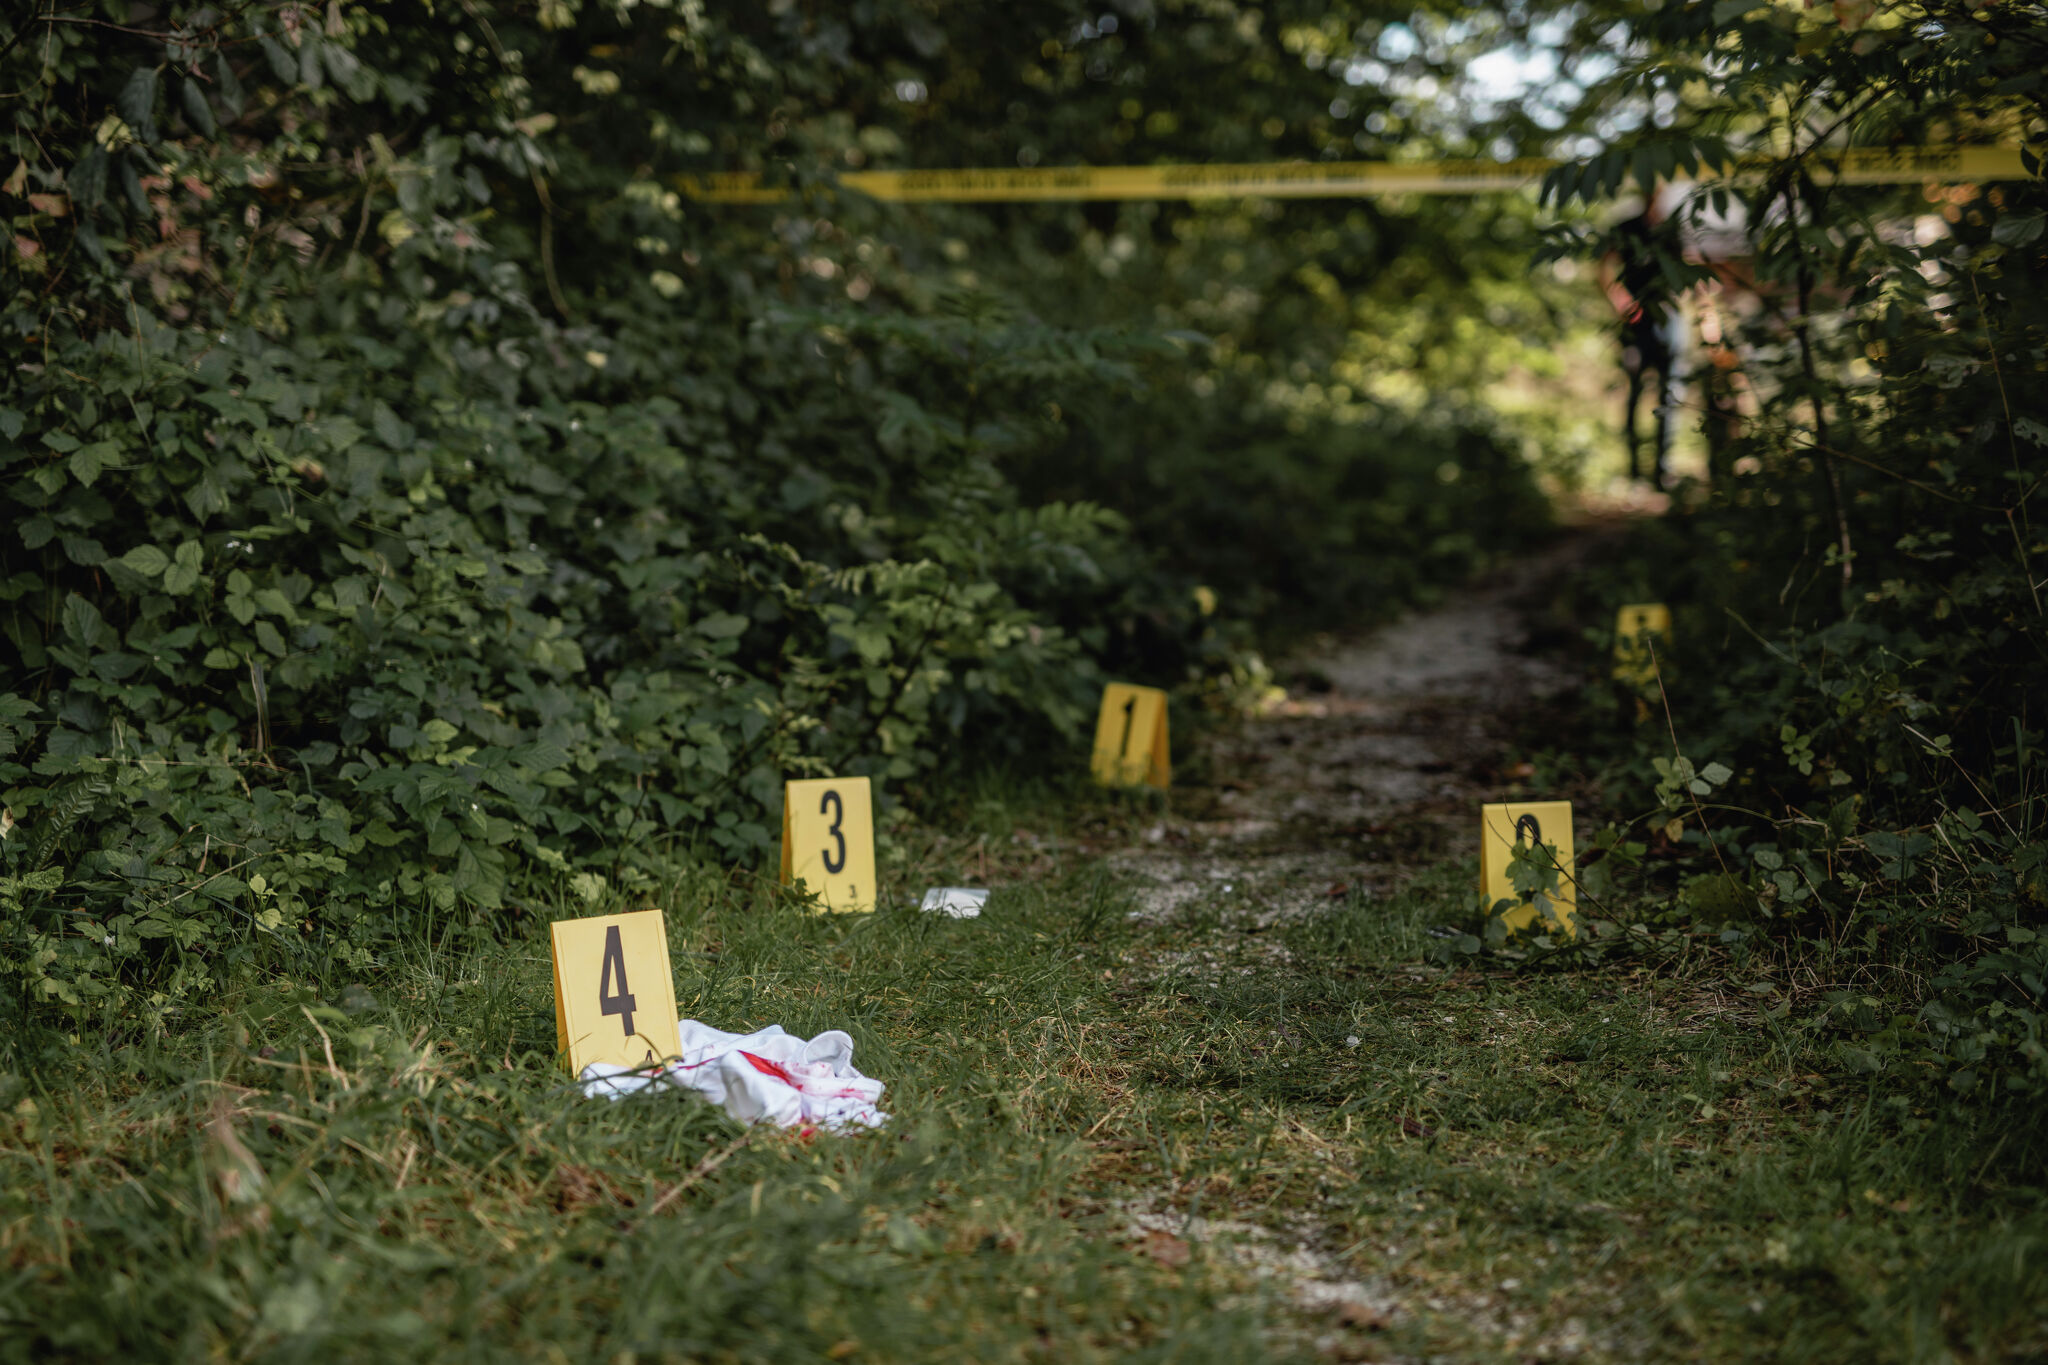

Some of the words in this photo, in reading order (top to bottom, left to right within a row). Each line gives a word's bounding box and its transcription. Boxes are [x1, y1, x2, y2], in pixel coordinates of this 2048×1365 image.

[1121, 695, 1138, 758] 1
[820, 790, 846, 874] 3
[600, 925, 637, 1037] 4
